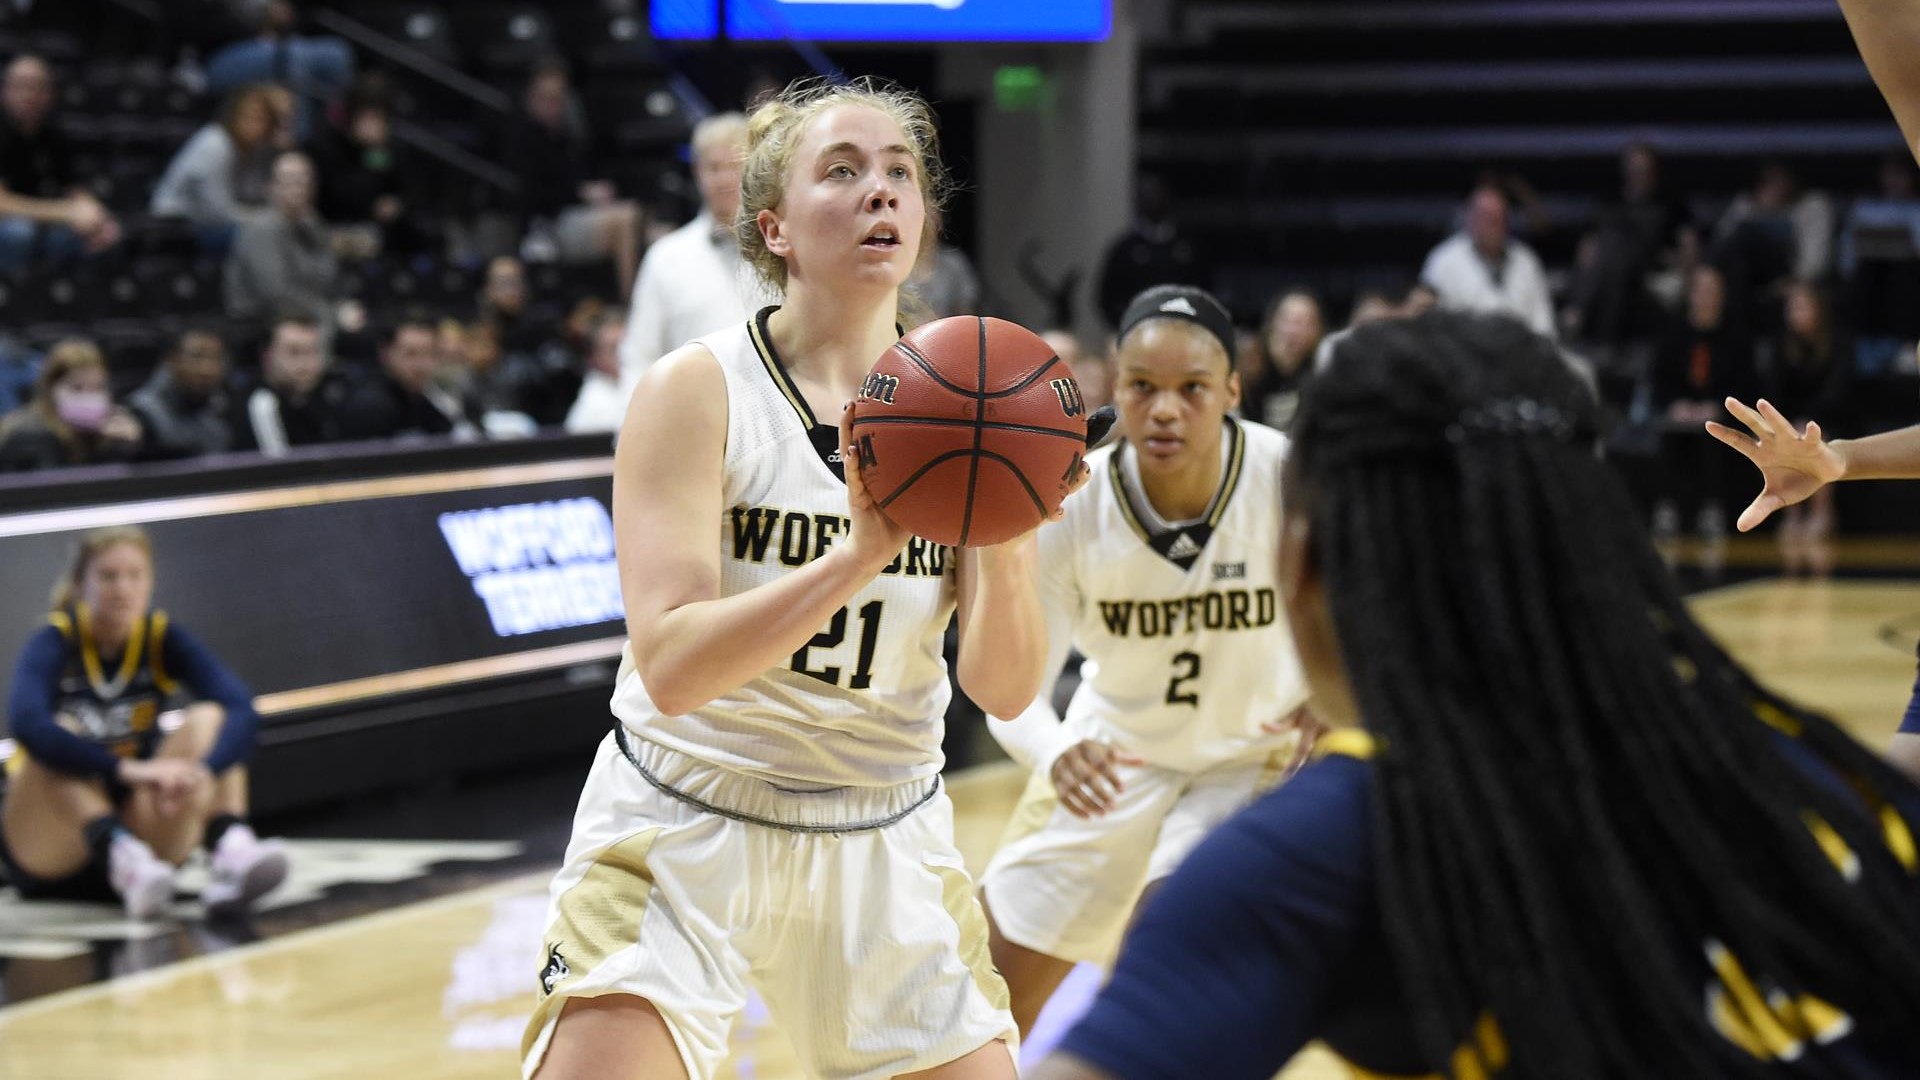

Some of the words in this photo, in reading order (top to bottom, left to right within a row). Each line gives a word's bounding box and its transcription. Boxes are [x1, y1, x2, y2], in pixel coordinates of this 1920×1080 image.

[437, 496, 615, 577] WOFFORD
[731, 505, 945, 576] WOFRD
[790, 600, 883, 689] 21
[1098, 587, 1275, 637] WOFFORD
[1165, 651, 1201, 706] 2
